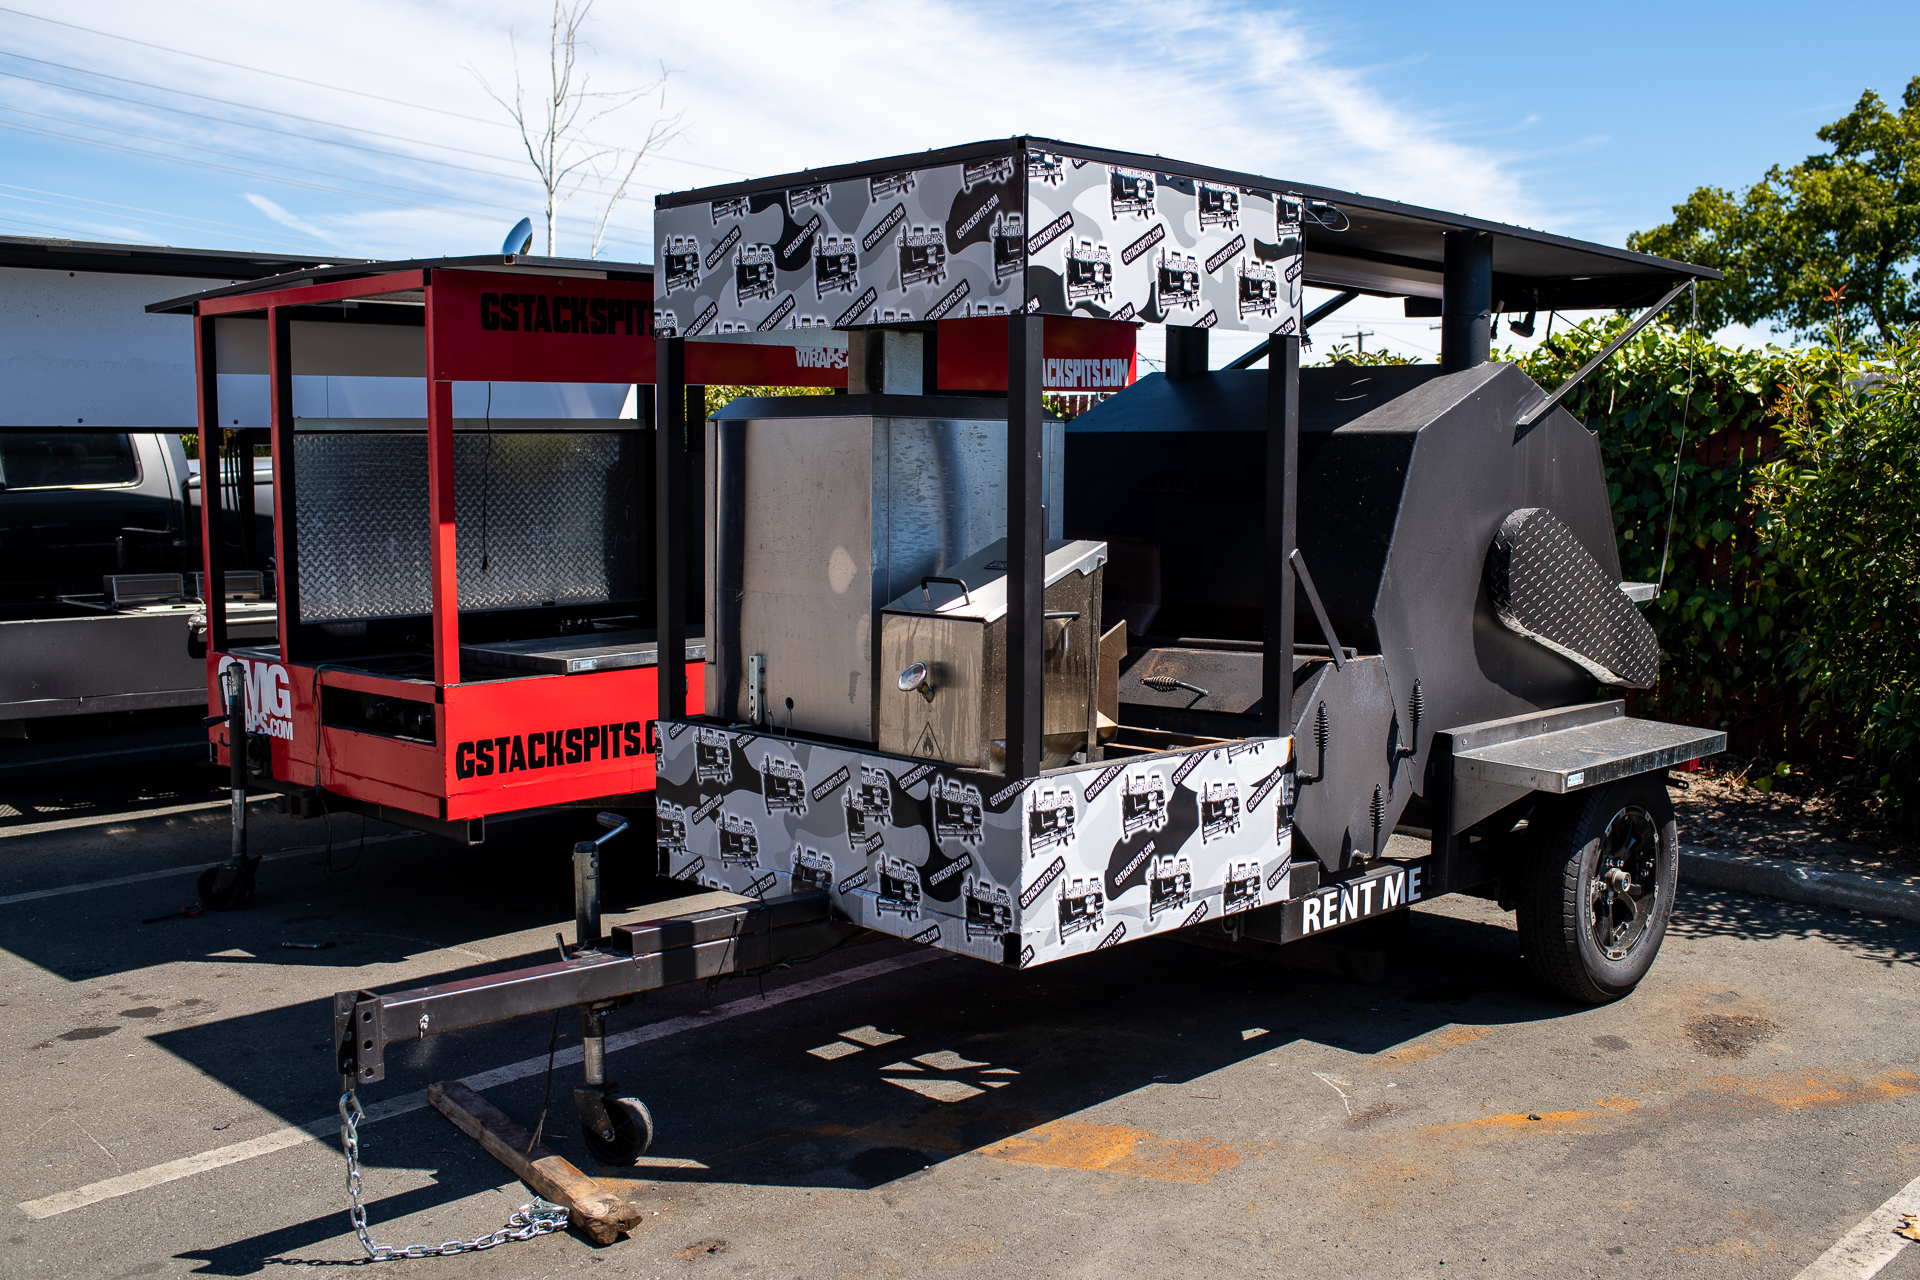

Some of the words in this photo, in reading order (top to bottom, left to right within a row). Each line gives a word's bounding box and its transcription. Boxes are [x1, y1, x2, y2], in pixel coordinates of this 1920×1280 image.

[784, 216, 820, 259] GSTACKSPITS.COM
[865, 205, 905, 250] GSTACKSPITS.COM
[956, 193, 1000, 240] GSTACKSPITS.COM
[1028, 214, 1072, 253] GSTACKSPITS.COM
[706, 226, 741, 269] GSTACKSPITS.COM
[1123, 226, 1164, 262] GSTACKSPITS.COM
[1207, 236, 1245, 273] GSTACKSPITS.COM
[225, 709, 293, 740] APS.COM
[813, 768, 850, 800] GSTACKSPITS.COM
[1247, 768, 1282, 811] GSTACKSPITS.COM
[693, 793, 723, 822] GSTACKSPITS.COM
[930, 854, 971, 887] GSTACKSPITS.COM
[1021, 858, 1064, 908] GSTACKSPITS.COM
[1114, 840, 1157, 887] GSTACKSPITS.COM
[1302, 879, 1377, 935] RENT
[1382, 866, 1422, 910] ME
